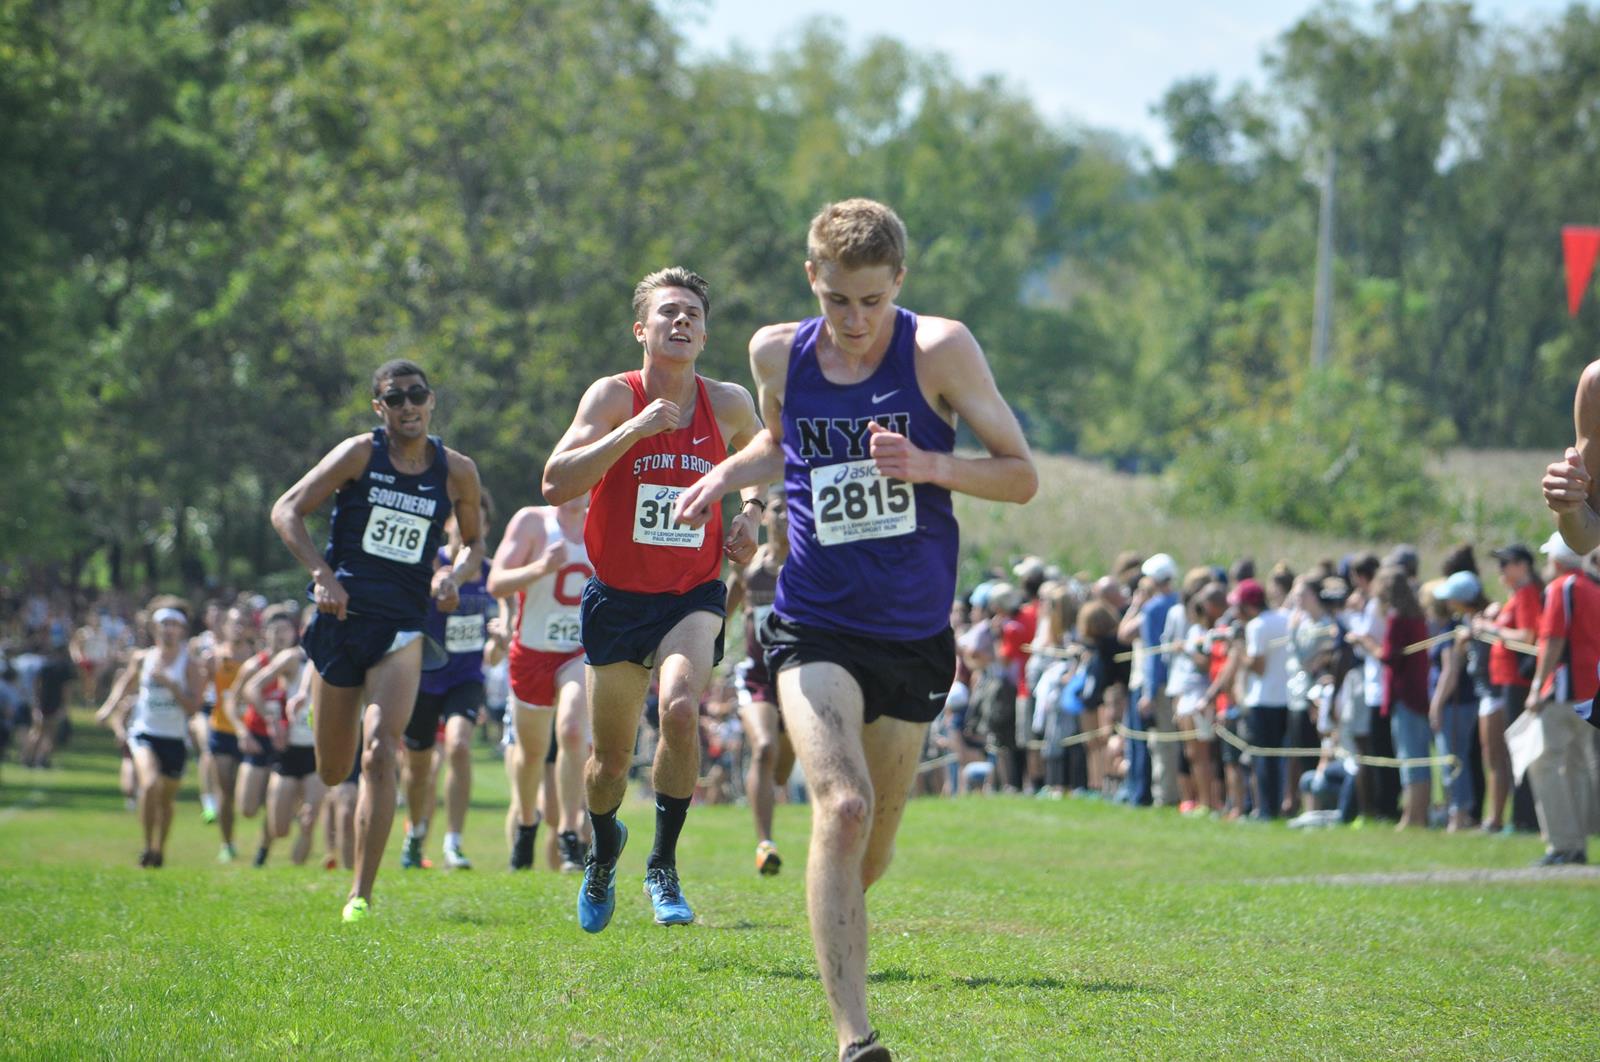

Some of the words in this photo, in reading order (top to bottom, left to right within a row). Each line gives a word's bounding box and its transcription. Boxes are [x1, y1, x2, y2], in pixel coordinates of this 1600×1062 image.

[633, 453, 676, 475] STONY
[681, 454, 715, 474] BROO
[850, 465, 880, 479] asic
[367, 486, 437, 517] SOUTHERN
[640, 500, 697, 530] 31
[818, 478, 910, 523] 2815
[371, 520, 421, 550] 3118
[553, 562, 593, 606] C
[549, 623, 579, 641] 212
